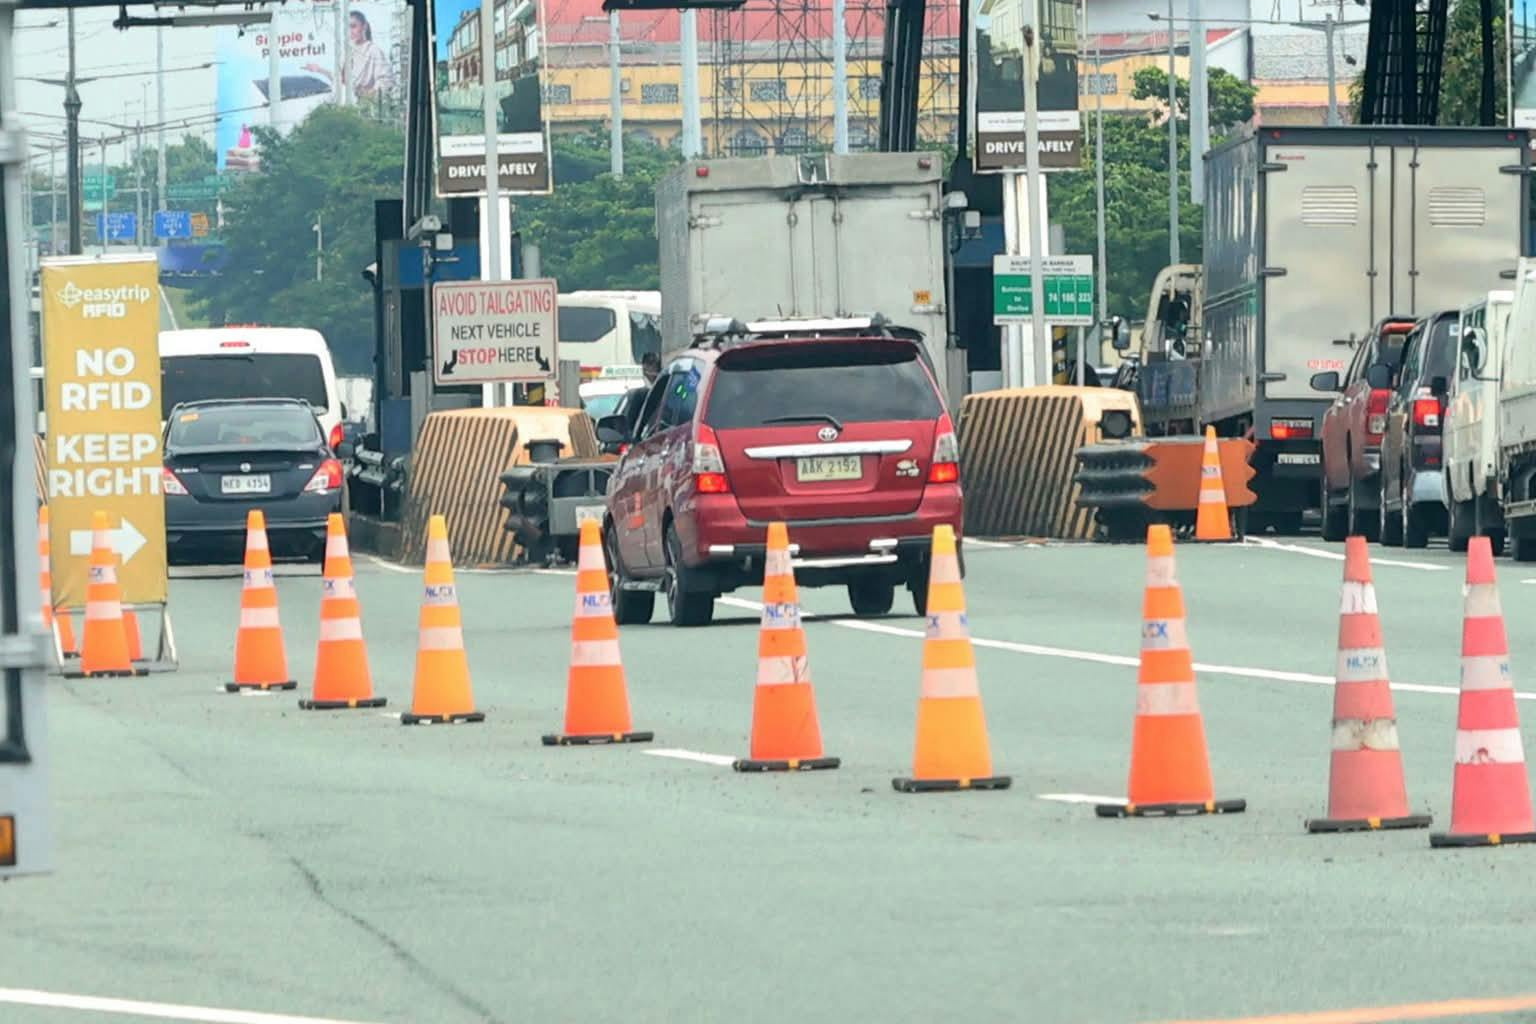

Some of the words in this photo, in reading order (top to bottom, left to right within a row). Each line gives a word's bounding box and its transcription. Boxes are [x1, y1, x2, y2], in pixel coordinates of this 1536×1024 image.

[262, 43, 326, 58] Pwerful
[985, 141, 1024, 154] DRIVE
[1038, 140, 1074, 153] AFELY
[448, 165, 487, 178] DRIVE
[498, 162, 537, 175] AFELY
[83, 284, 149, 305] easytrip
[440, 292, 476, 315] AVOID
[480, 289, 552, 314] TAILGATING
[82, 303, 125, 318] RFID
[451, 324, 483, 340] NEXT
[487, 322, 540, 338] VEHICLE
[76, 347, 135, 376] NO
[458, 347, 496, 365] STOP
[498, 347, 533, 363] HERE
[61, 381, 152, 411] RFID
[56, 433, 157, 464] KEEP
[49, 467, 163, 497] RIGHT
